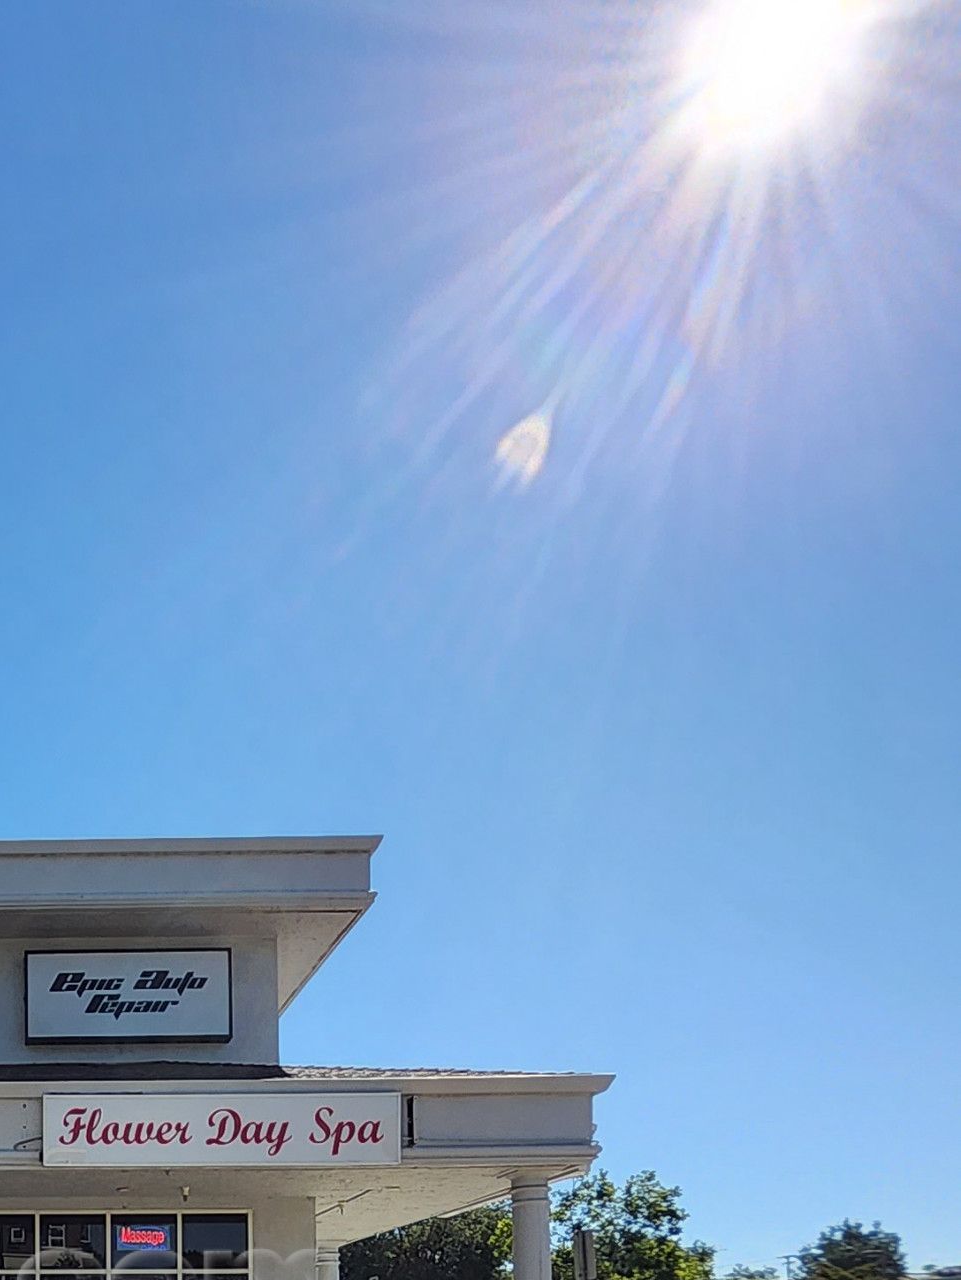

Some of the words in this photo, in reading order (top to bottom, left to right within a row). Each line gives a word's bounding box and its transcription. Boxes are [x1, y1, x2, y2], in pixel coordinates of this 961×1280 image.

[49, 971, 125, 998] Epic
[133, 970, 208, 996] Auto
[58, 1107, 193, 1146] Flower
[205, 1108, 293, 1156] Day
[308, 1106, 384, 1156] Spa
[121, 1226, 165, 1246] Massage
